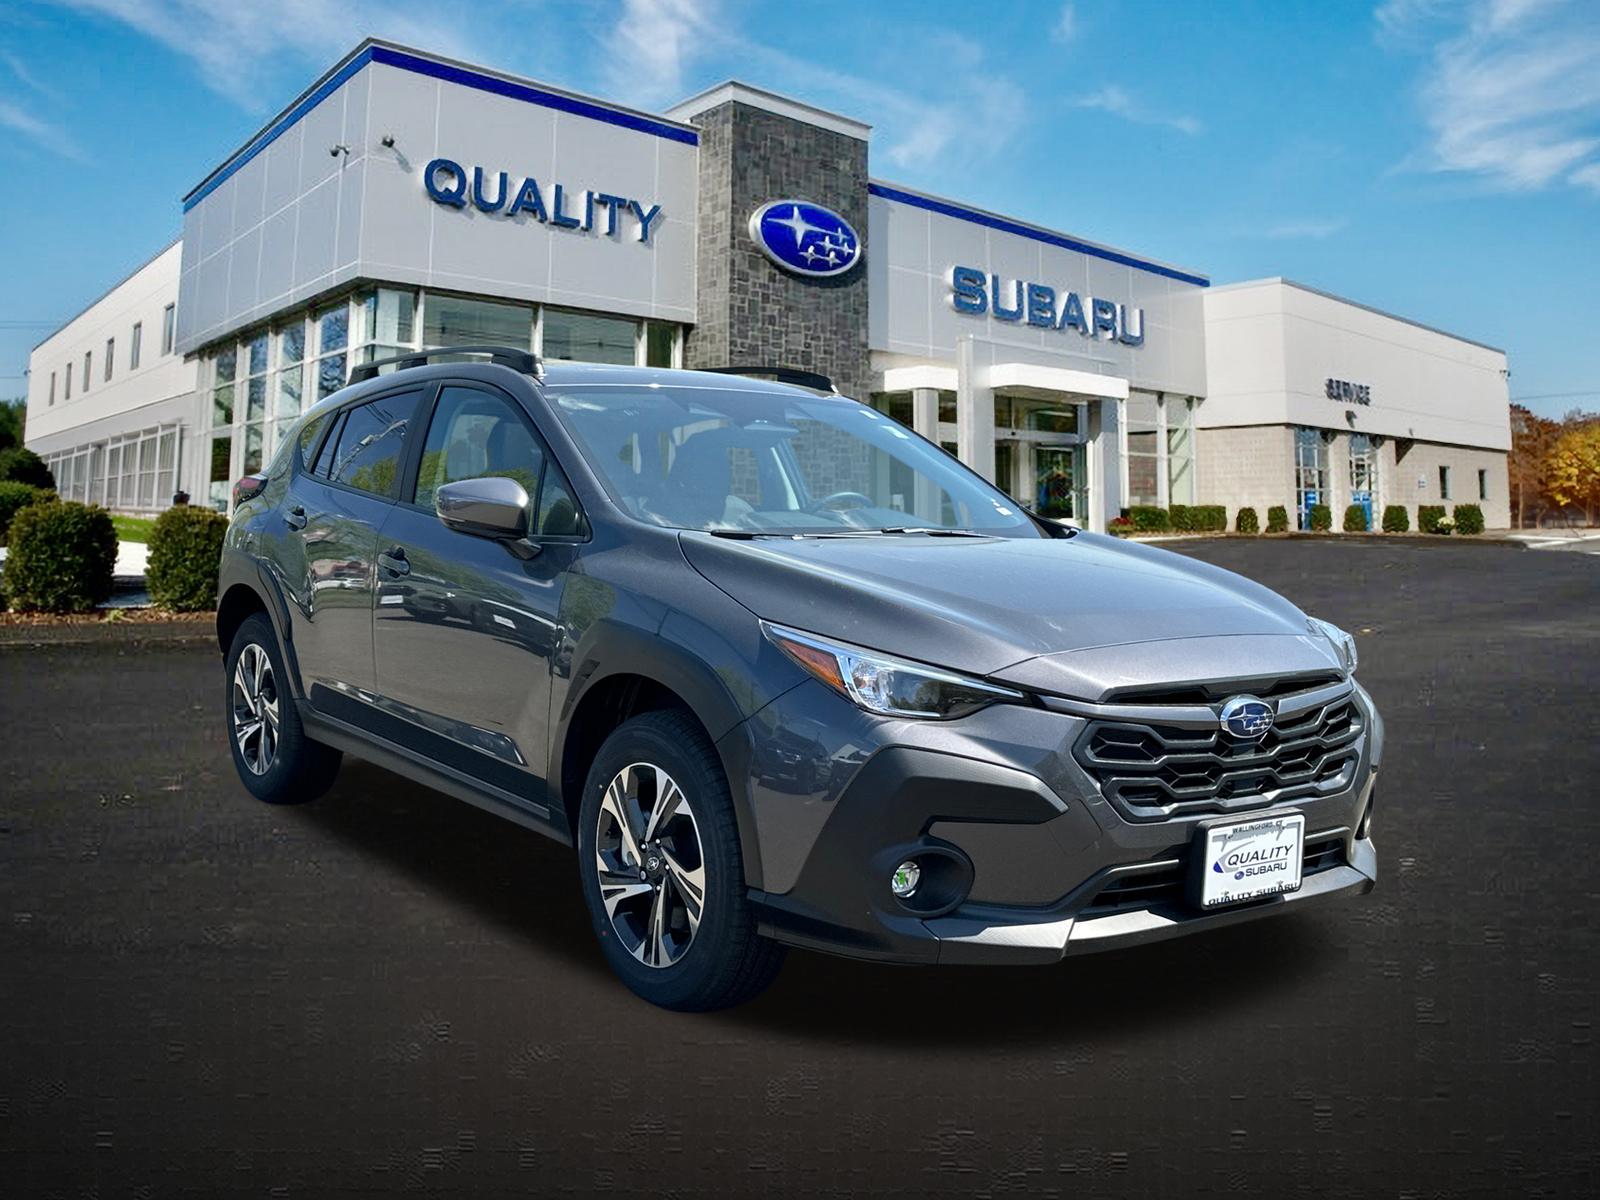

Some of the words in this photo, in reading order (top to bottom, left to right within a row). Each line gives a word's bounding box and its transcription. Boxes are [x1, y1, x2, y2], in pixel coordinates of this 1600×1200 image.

[423, 158, 662, 242] QUALITY
[950, 265, 1146, 347] SUBARU
[1227, 844, 1294, 866] QUALITY
[1245, 862, 1288, 877] SUBARU
[1208, 891, 1253, 905] QUALITY
[1256, 882, 1299, 896] SUBARU
